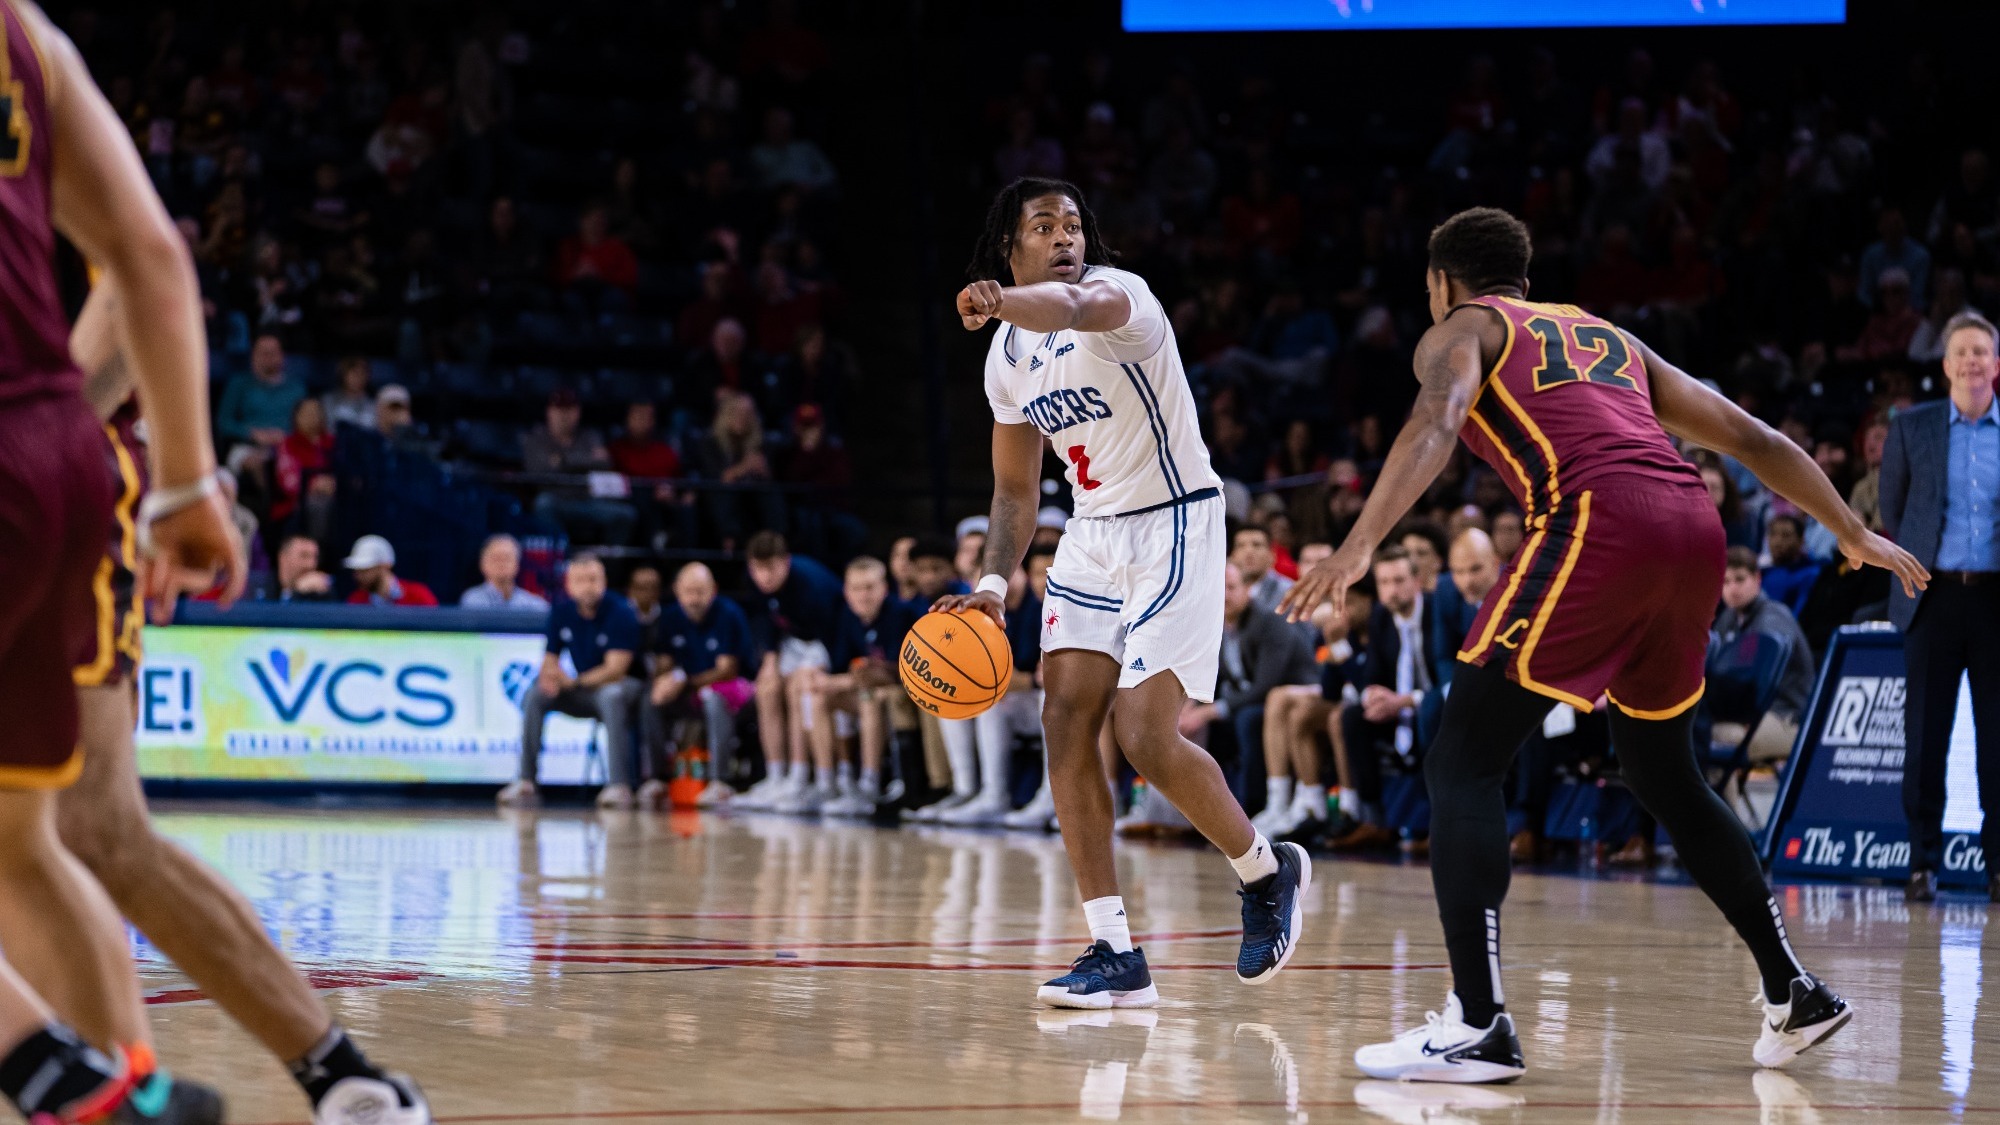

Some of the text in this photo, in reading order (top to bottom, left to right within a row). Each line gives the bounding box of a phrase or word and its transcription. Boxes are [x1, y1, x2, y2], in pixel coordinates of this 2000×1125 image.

[1522, 314, 1641, 394] 12
[248, 659, 456, 727] VCS
[902, 677, 940, 714] CAA
[903, 640, 958, 698] Wilson
[1801, 827, 1846, 867] The
